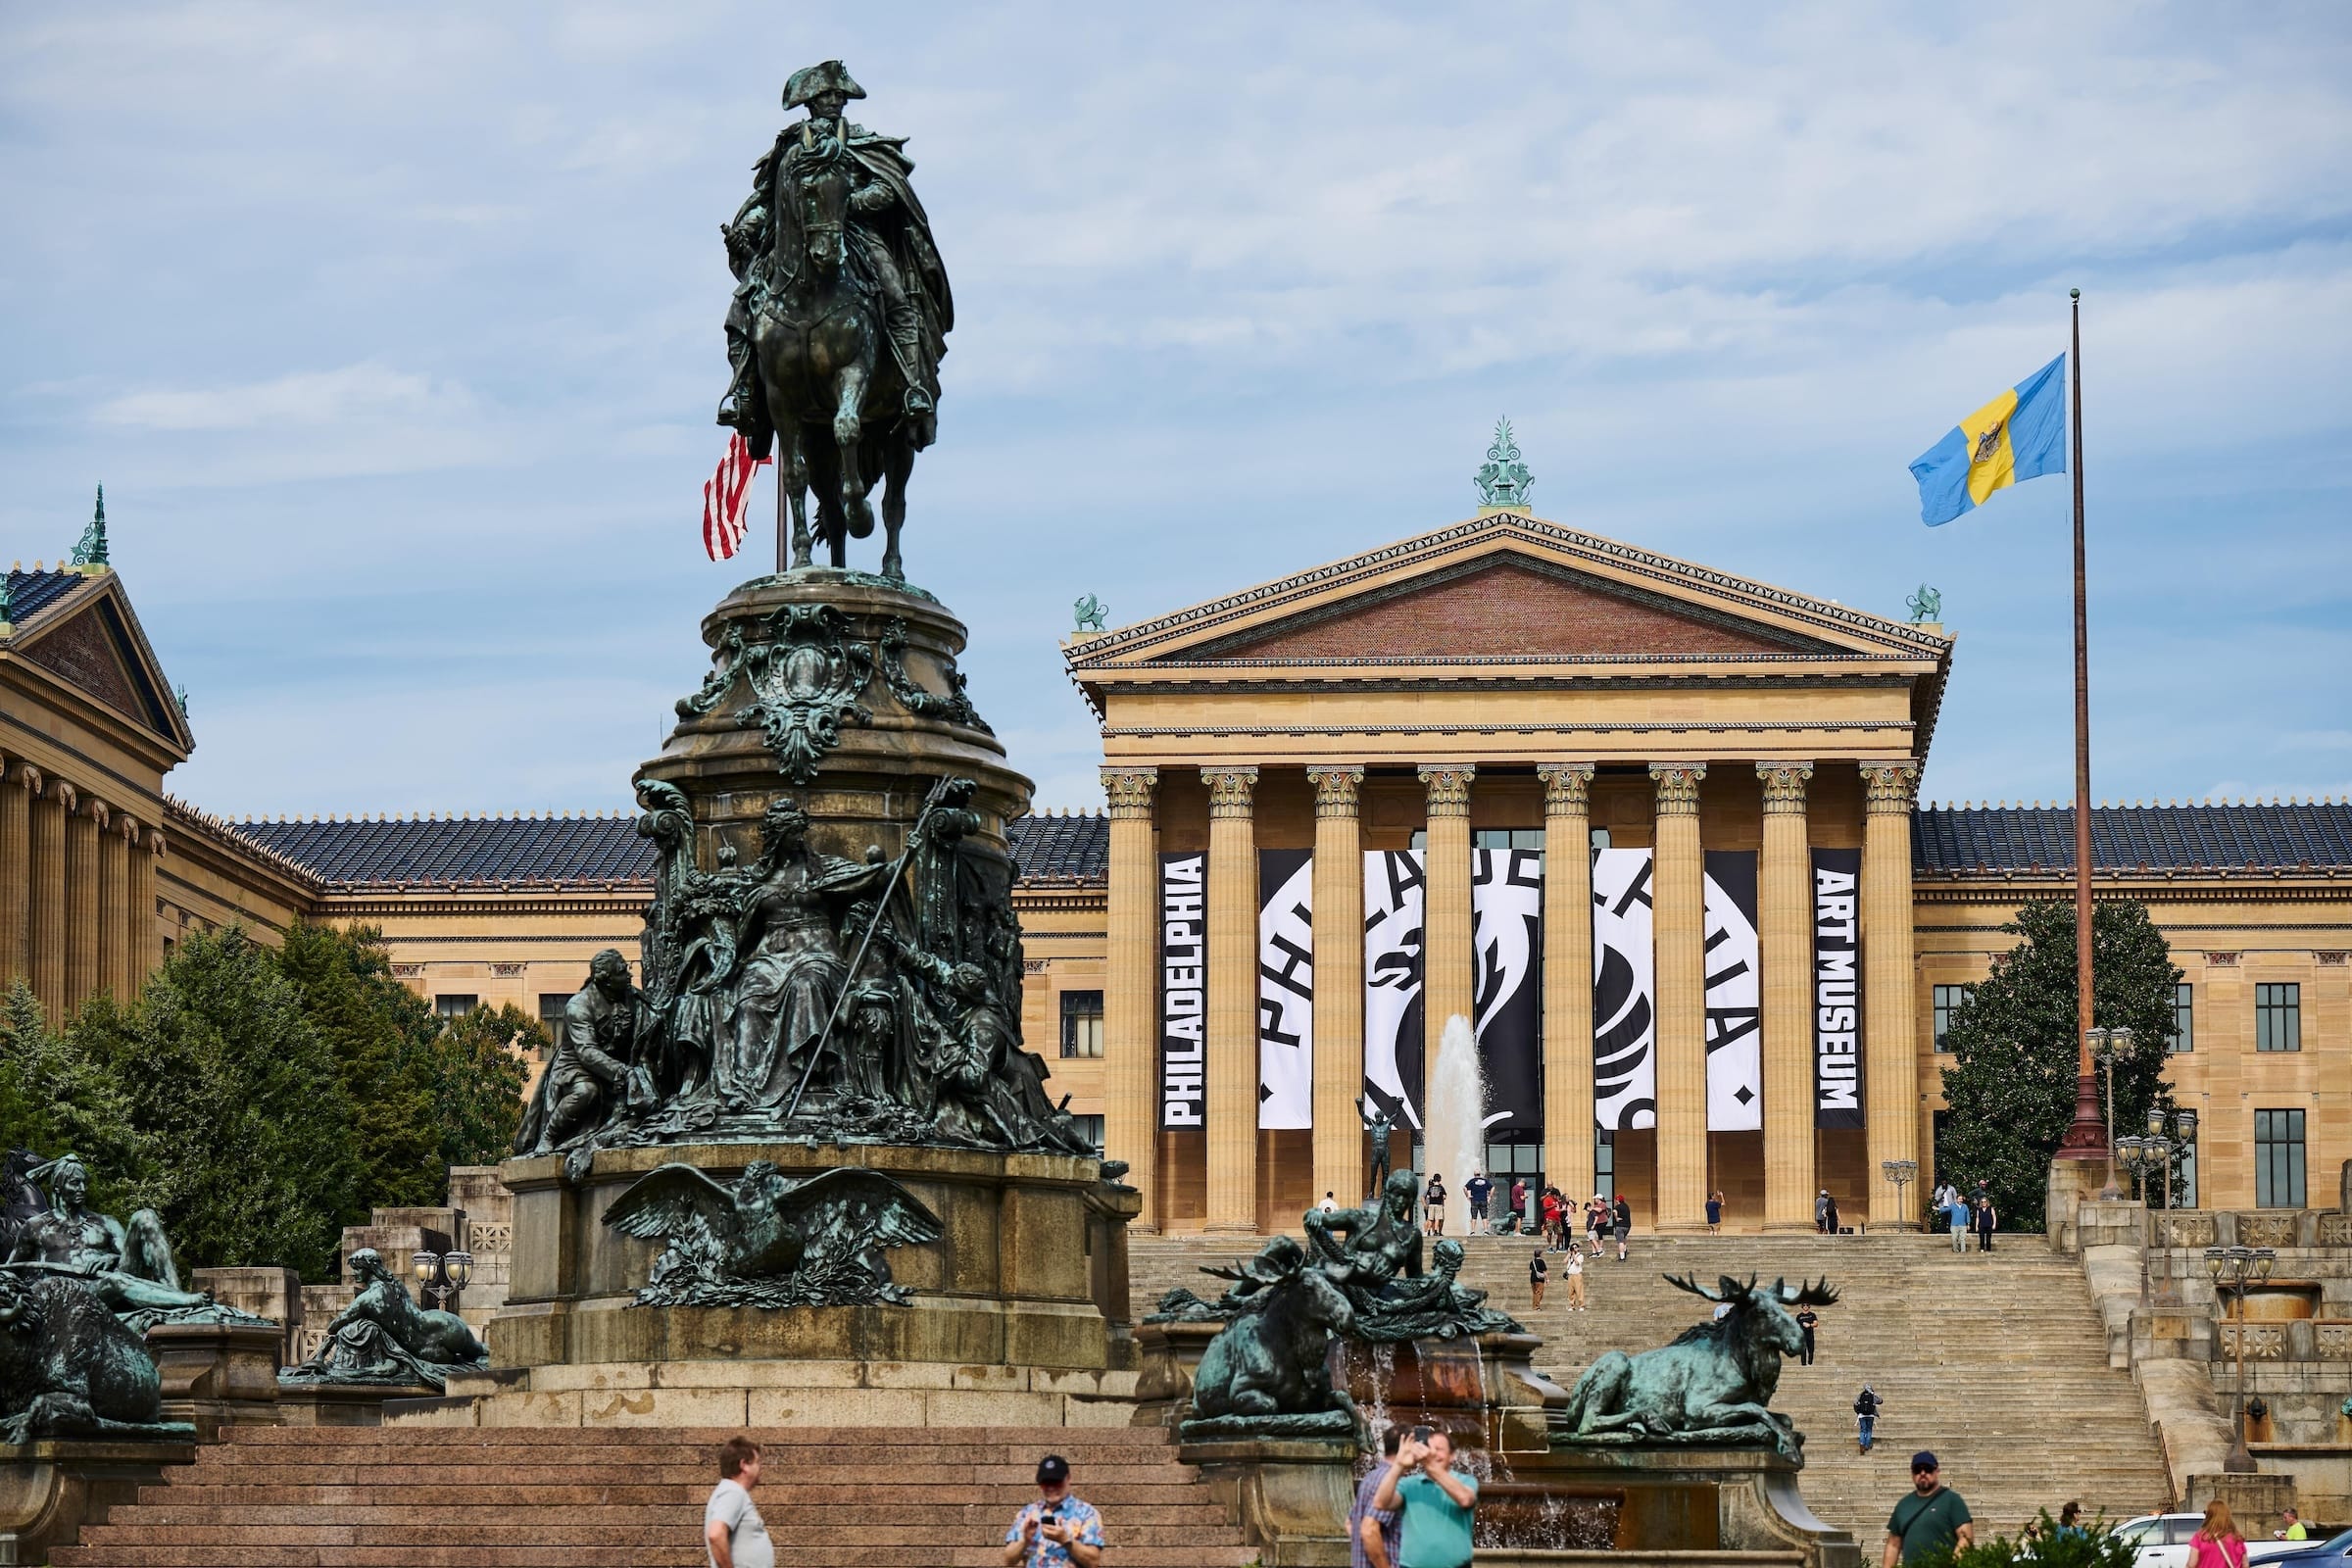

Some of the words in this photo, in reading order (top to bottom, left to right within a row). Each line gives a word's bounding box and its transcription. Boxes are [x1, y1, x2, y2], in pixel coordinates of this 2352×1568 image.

[1817, 868, 1855, 944] ART
[1164, 855, 1202, 1126] PHILADELPHIA
[1818, 949, 1858, 1110] MUSEUM
